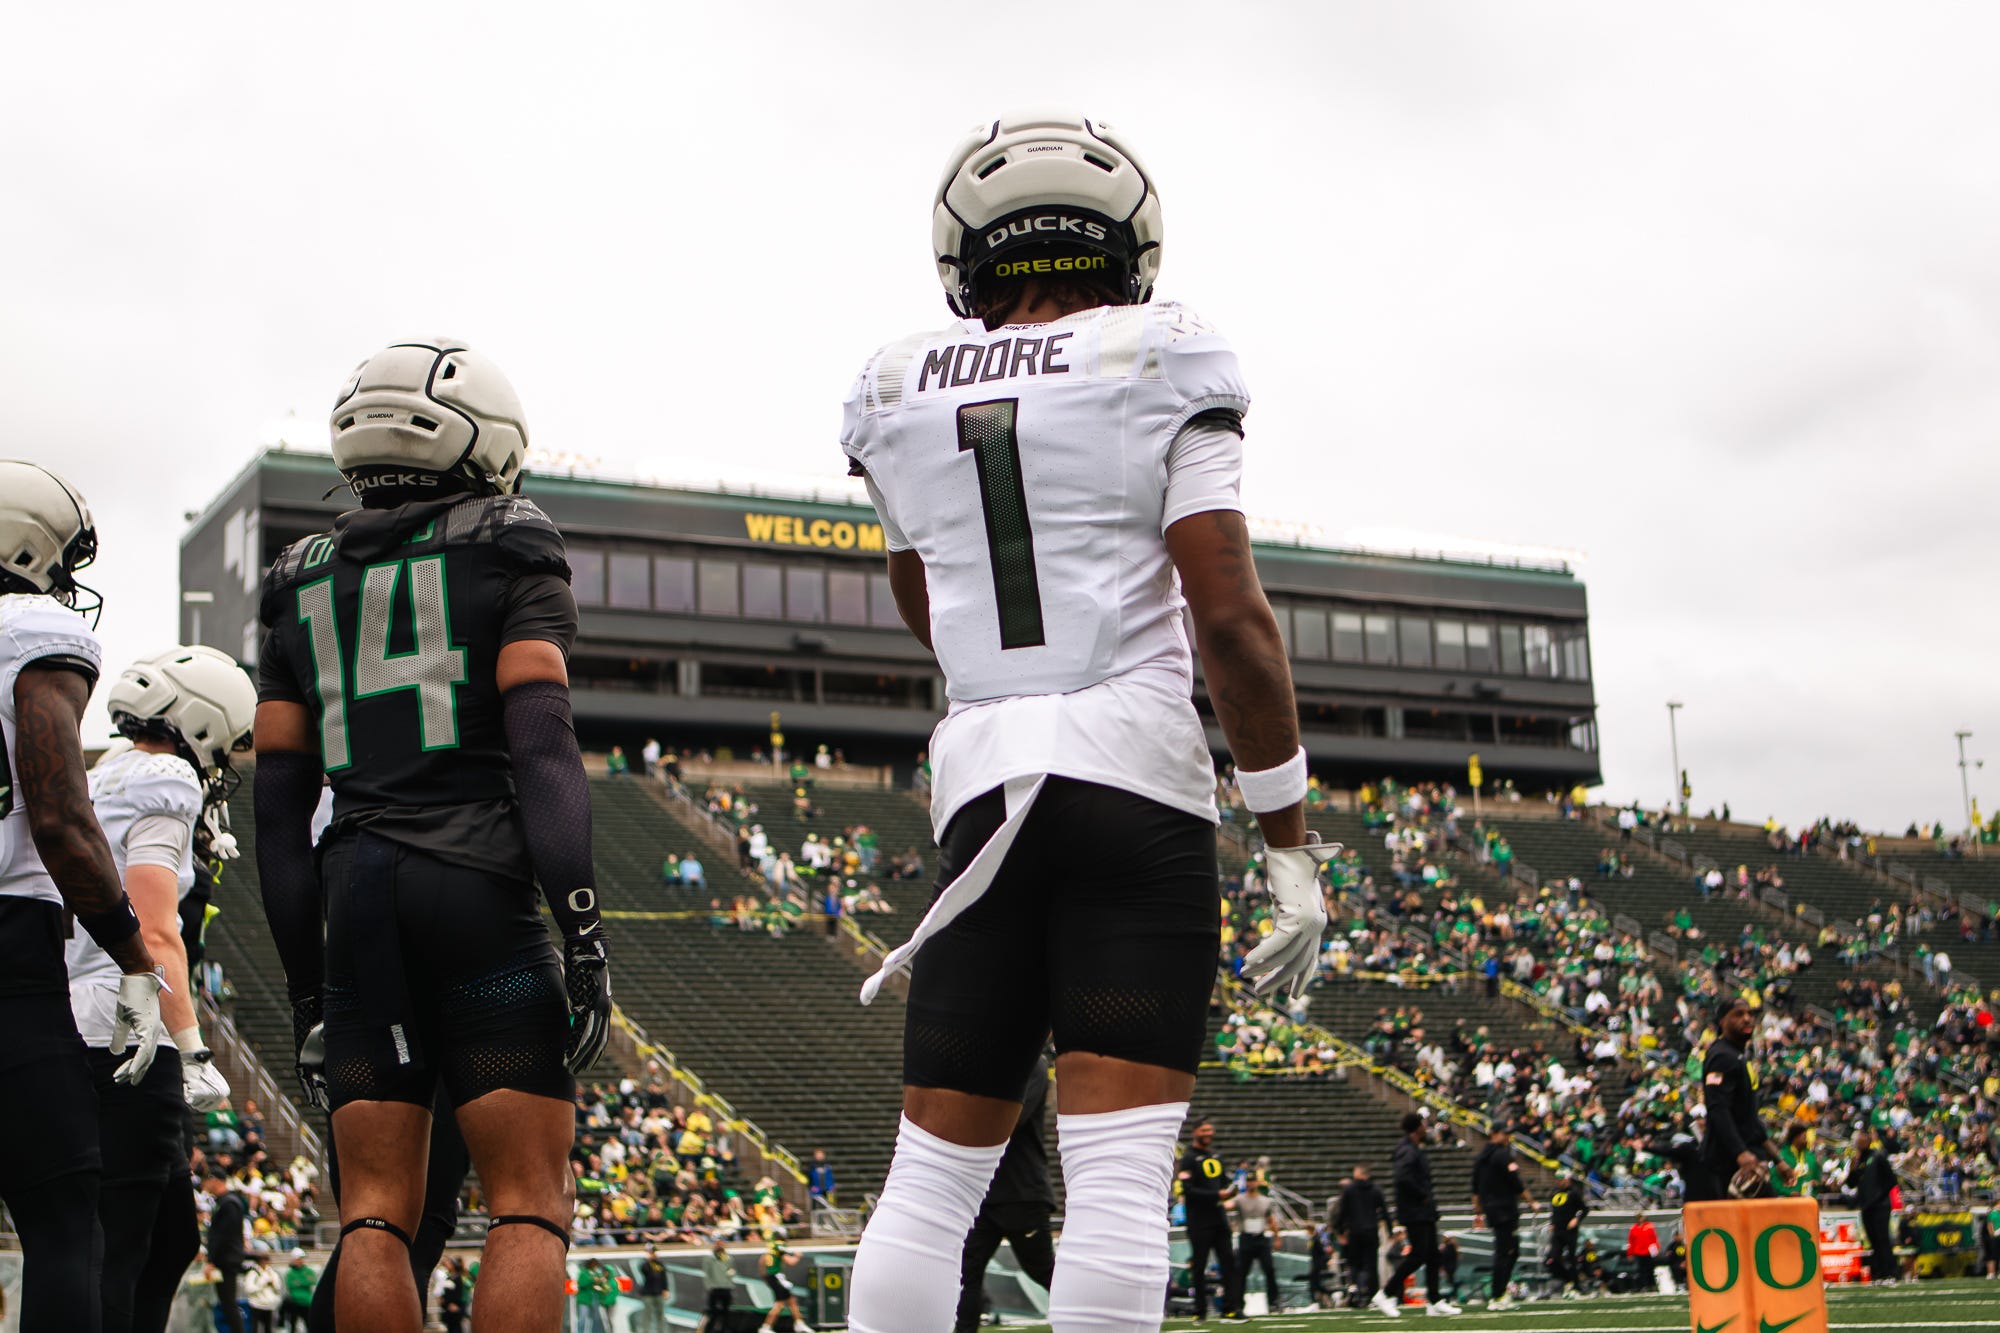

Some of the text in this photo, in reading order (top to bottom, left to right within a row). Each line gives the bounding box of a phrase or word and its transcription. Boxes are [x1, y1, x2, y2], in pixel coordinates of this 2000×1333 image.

[986, 216, 1107, 248] DUCKS
[995, 256, 1105, 277] OREGON
[918, 332, 1074, 392] MOORE
[353, 474, 440, 494] DUCKS
[744, 512, 888, 552] WELCOM
[956, 397, 1046, 650] 1
[296, 553, 469, 773] 14
[568, 888, 595, 912] O
